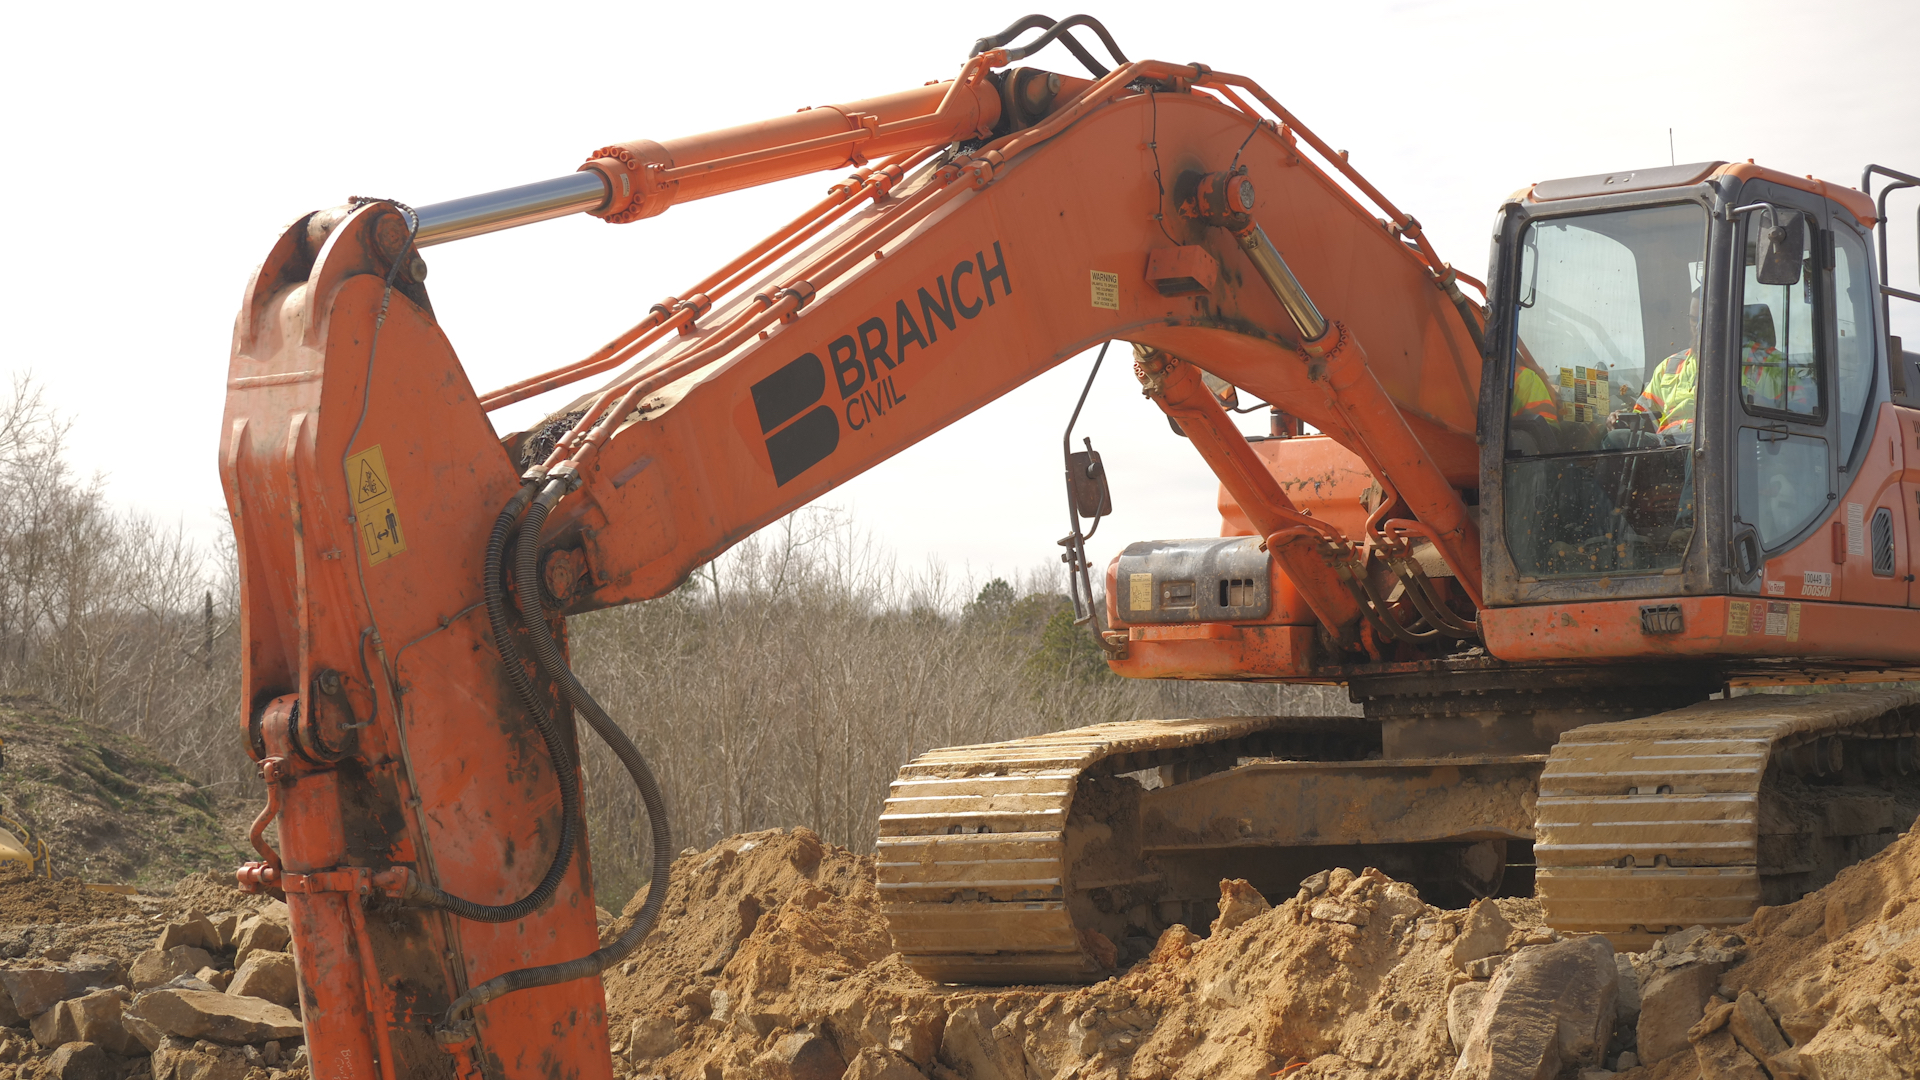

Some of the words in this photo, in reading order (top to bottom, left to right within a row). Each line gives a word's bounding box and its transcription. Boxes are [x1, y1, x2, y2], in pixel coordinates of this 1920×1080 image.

[1092, 272, 1117, 284] WARNING
[828, 240, 1013, 401] BRANCH
[846, 375, 907, 431] CIVIL
[1801, 585, 1832, 597] DOOSAN
